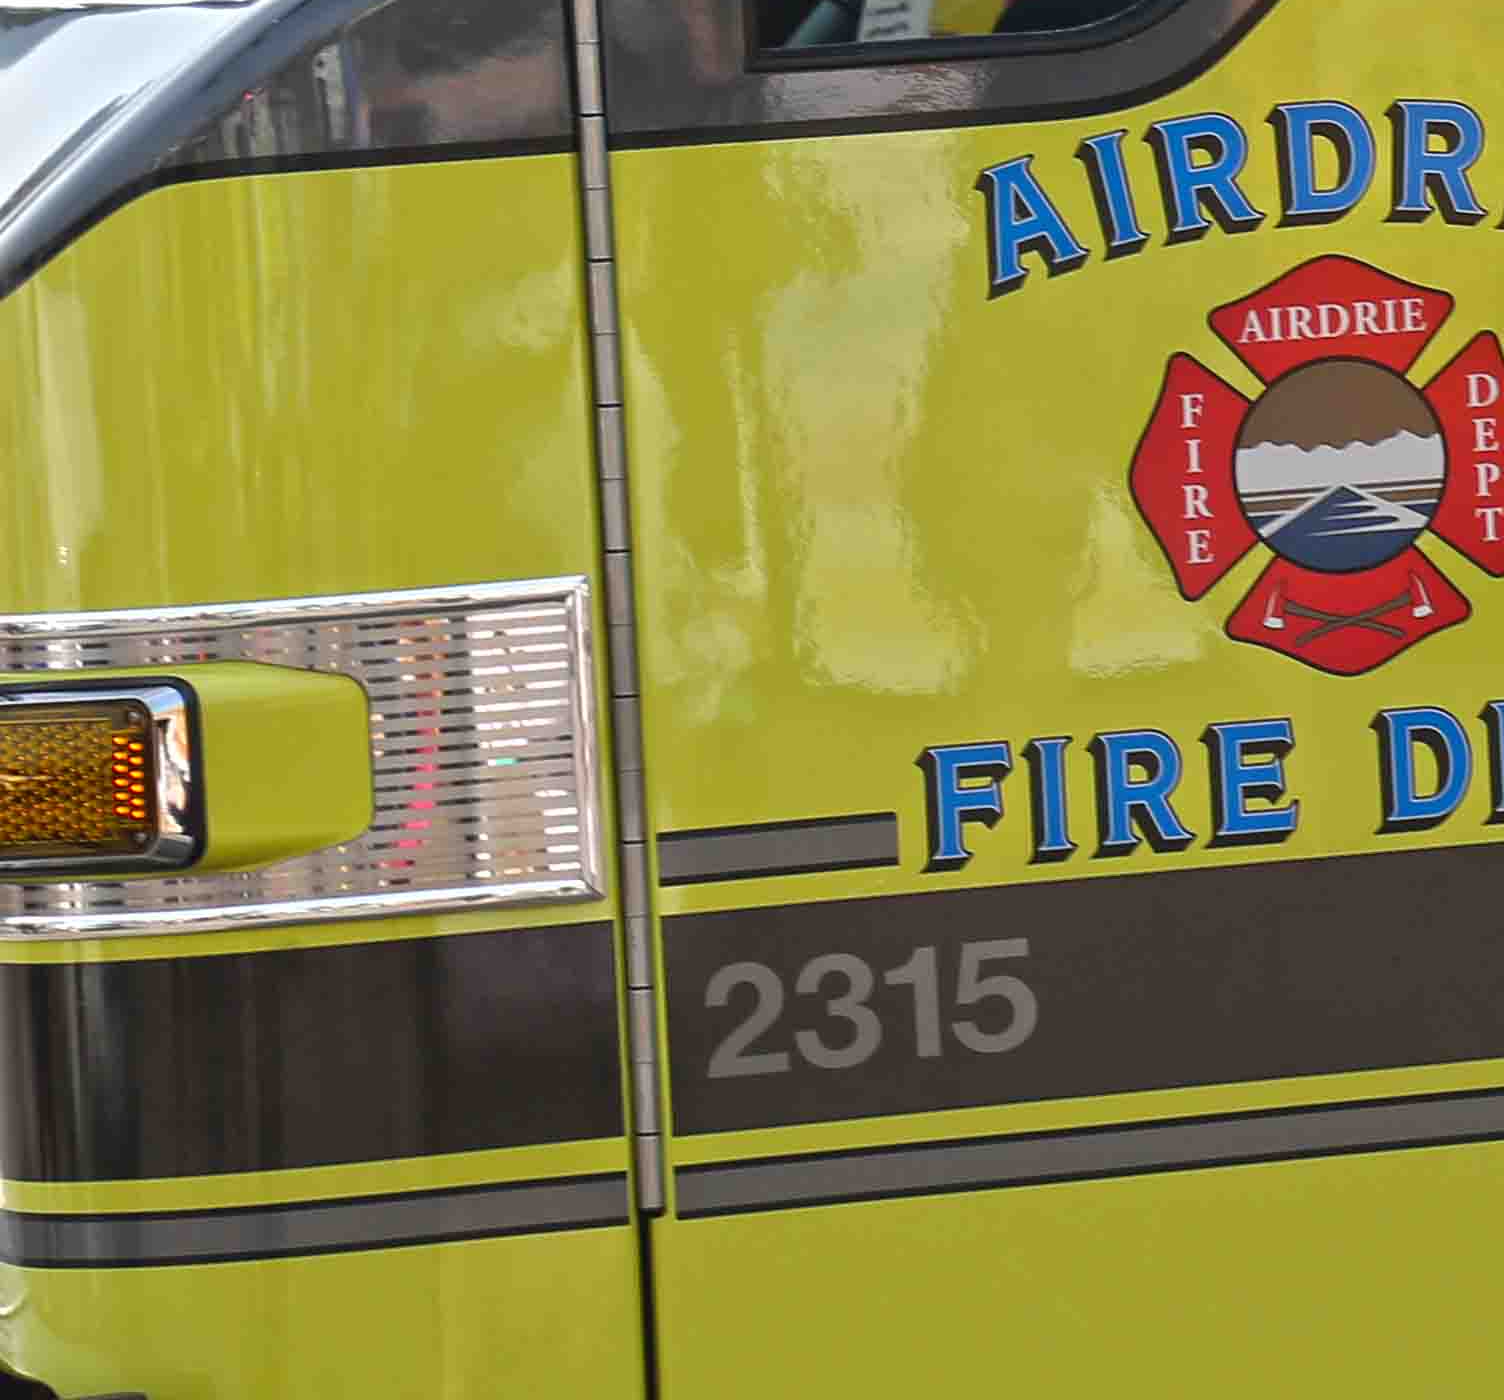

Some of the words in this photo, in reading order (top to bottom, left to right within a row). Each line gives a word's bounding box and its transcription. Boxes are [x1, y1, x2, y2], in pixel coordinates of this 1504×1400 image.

[1236, 298, 1428, 343] AIRDRIE
[1180, 393, 1216, 565] FIRE
[1465, 373, 1503, 543] DEPT
[916, 718, 1300, 873] FIRE
[705, 938, 1039, 1079] 2315
